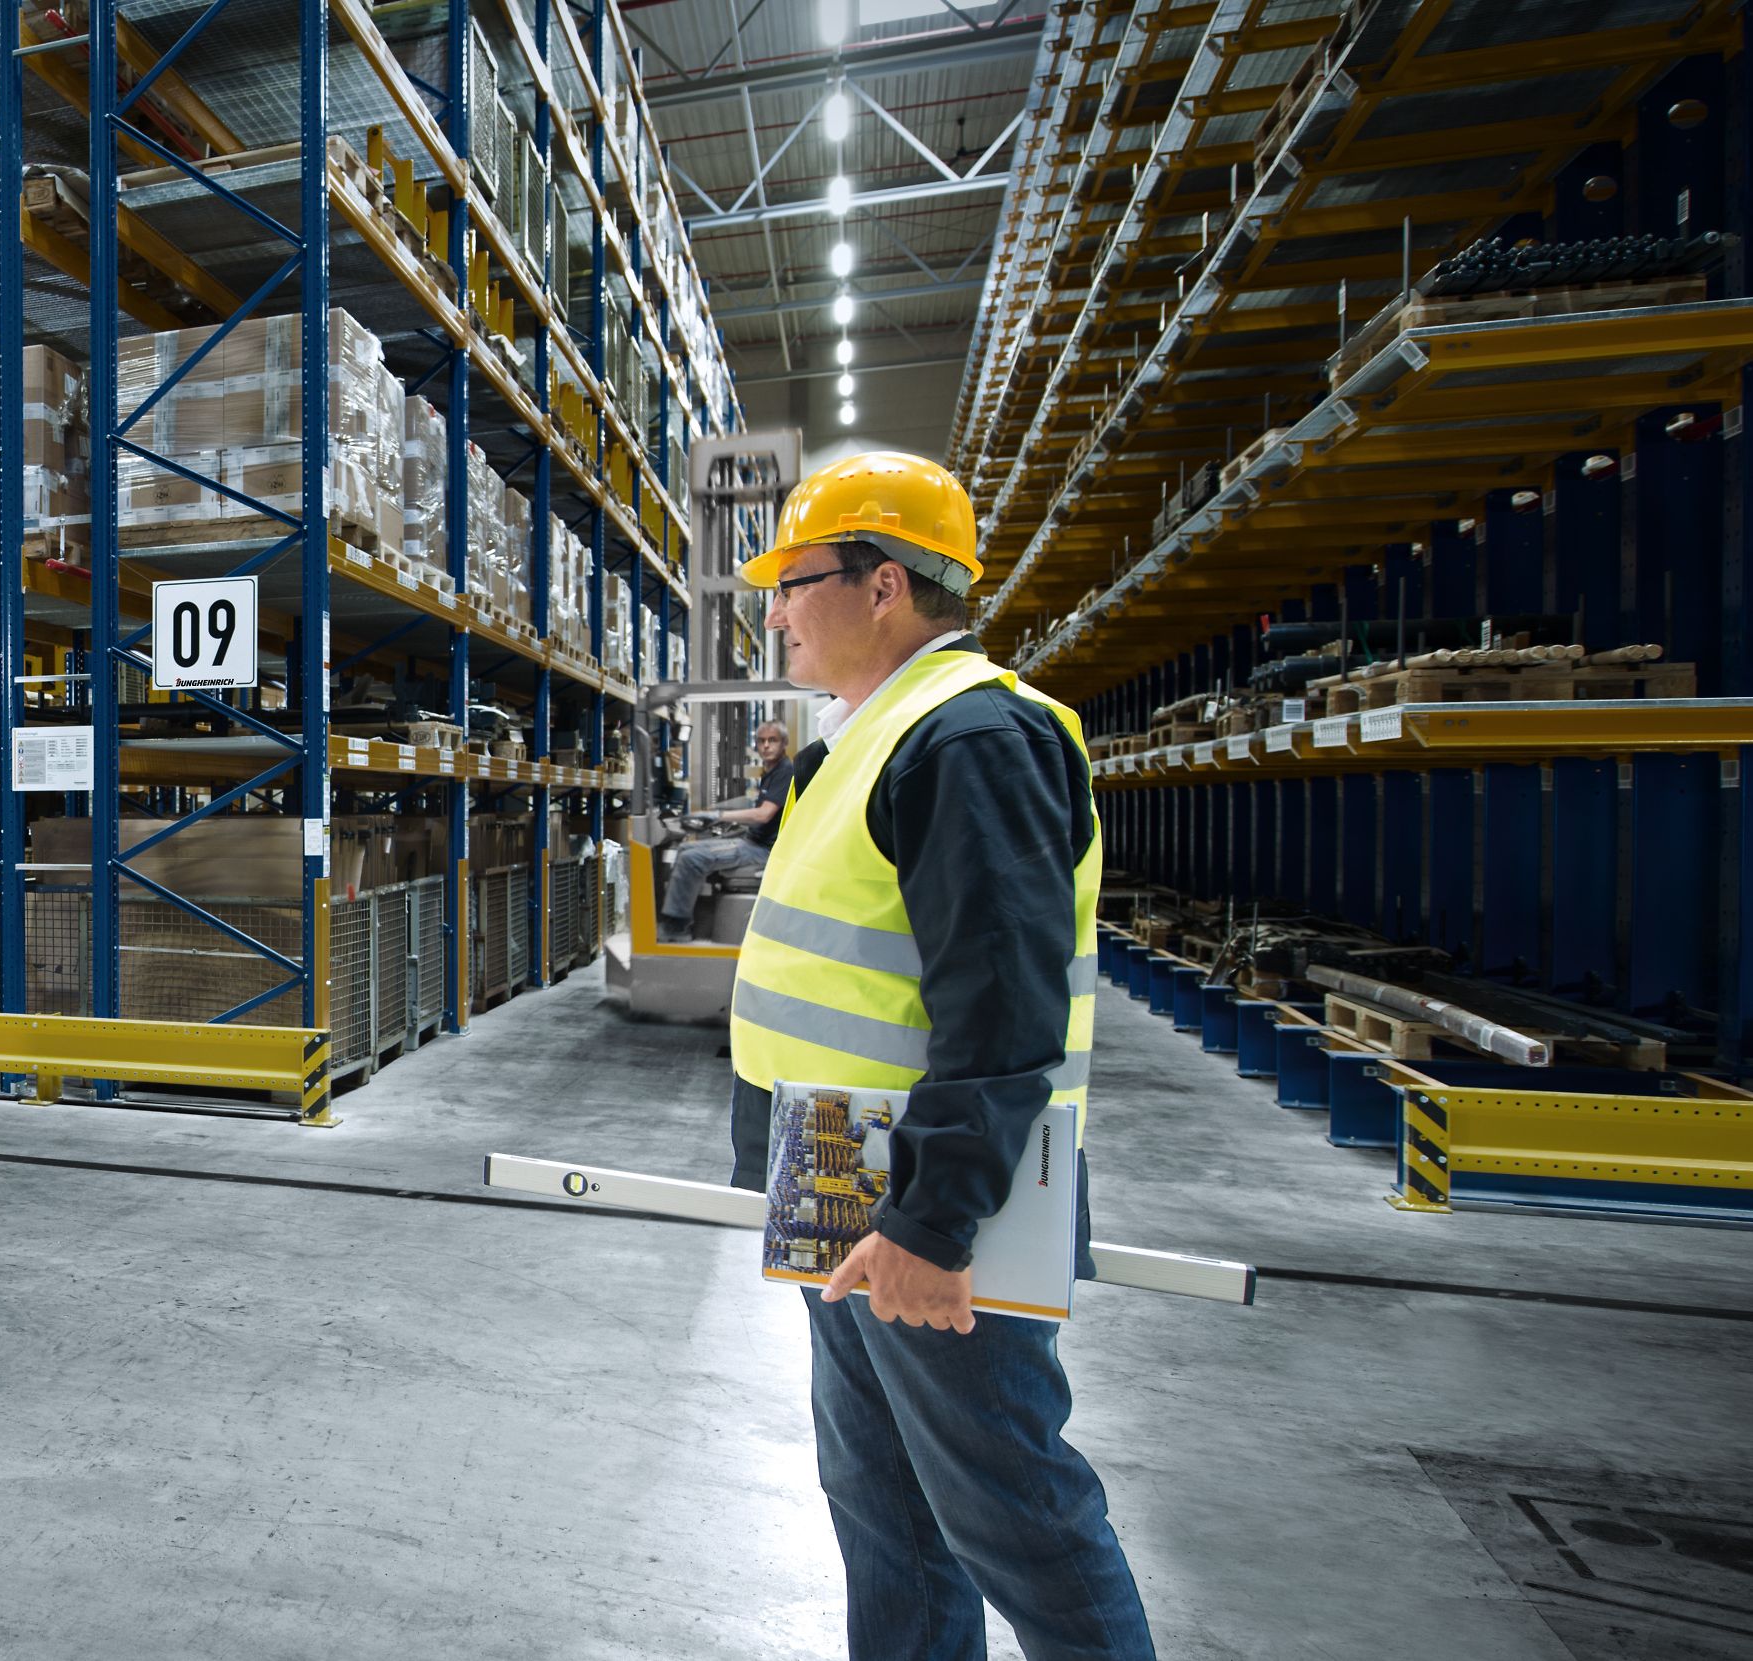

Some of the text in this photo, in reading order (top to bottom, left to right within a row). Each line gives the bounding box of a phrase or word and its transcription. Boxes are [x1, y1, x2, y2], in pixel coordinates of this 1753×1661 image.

[173, 599, 236, 668] 09
[175, 678, 235, 687] JUNGHEINRICH
[1037, 1124, 1051, 1188] JUNGHEINRICH
